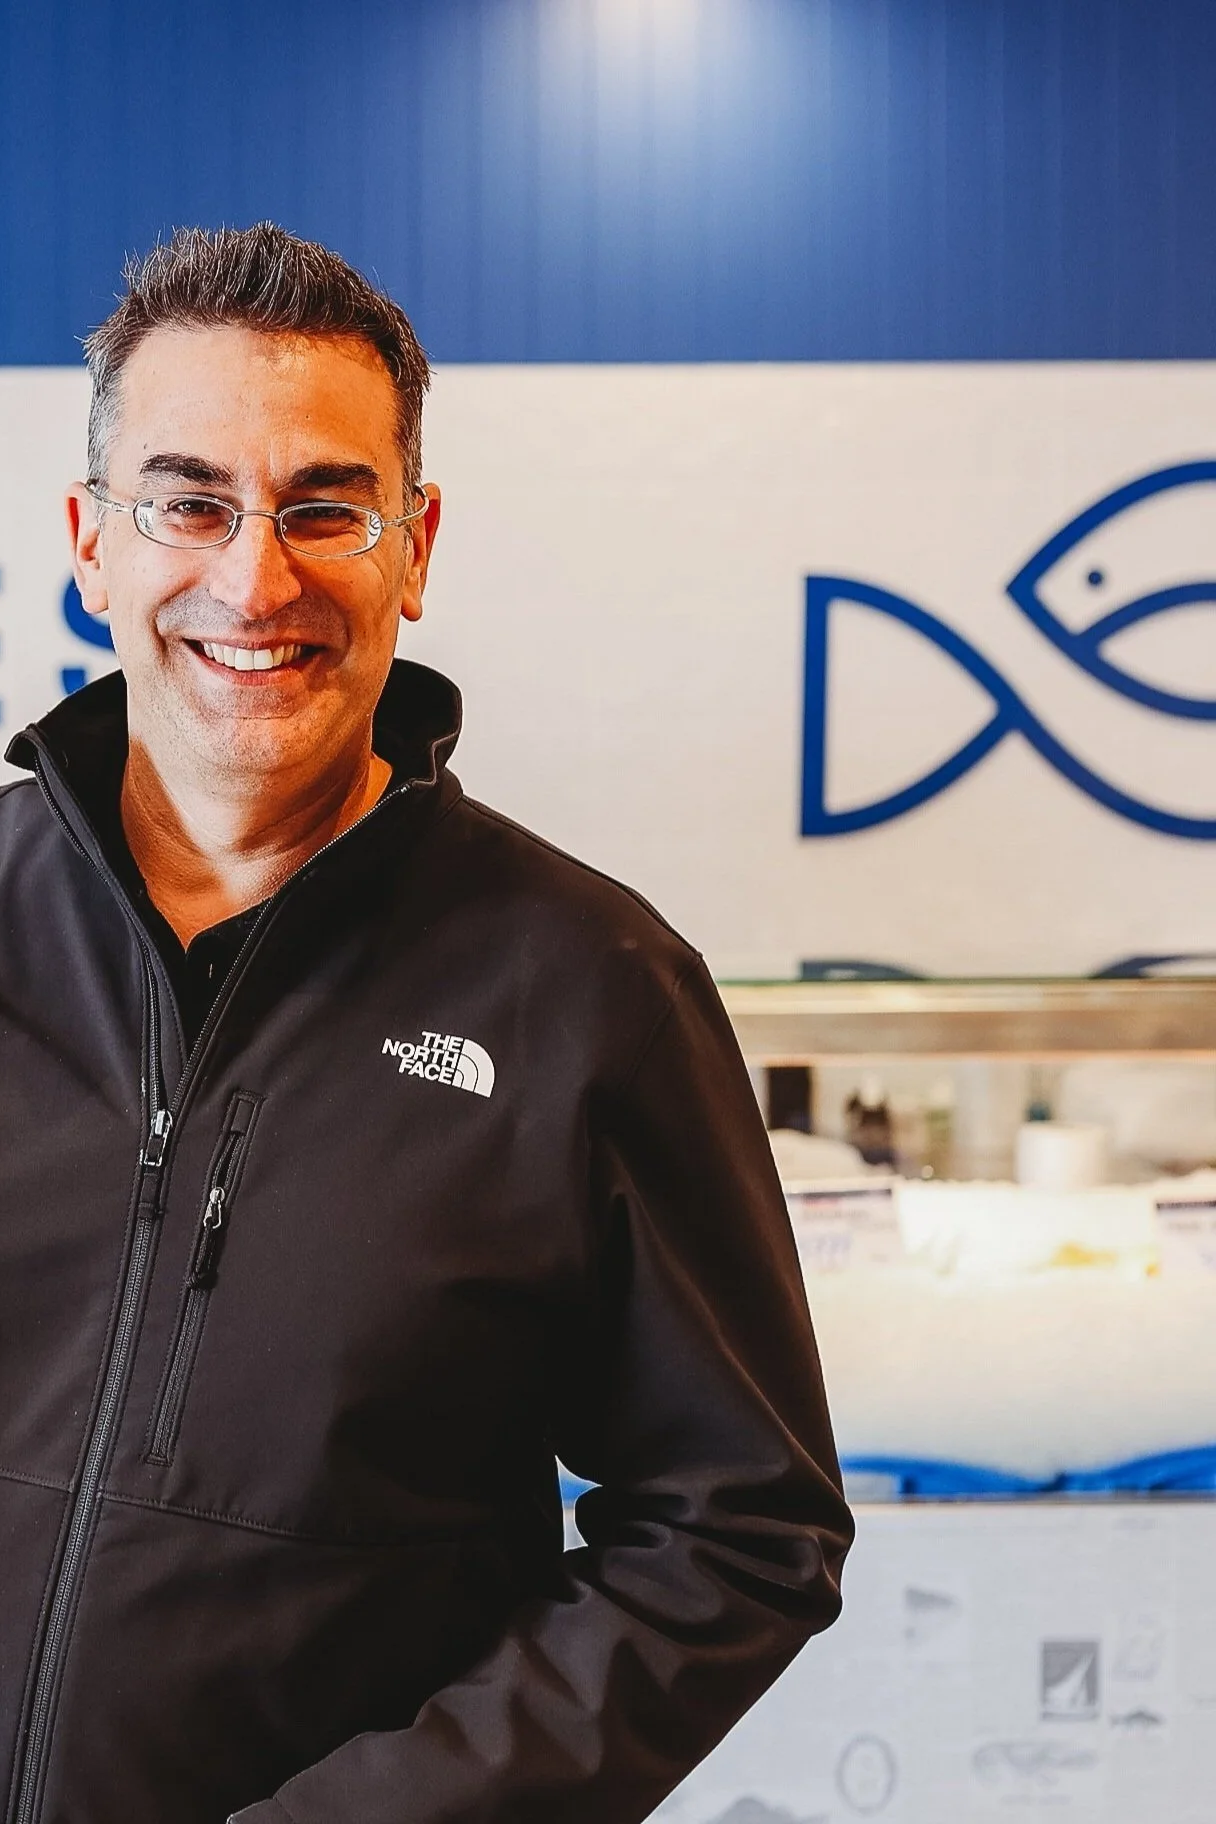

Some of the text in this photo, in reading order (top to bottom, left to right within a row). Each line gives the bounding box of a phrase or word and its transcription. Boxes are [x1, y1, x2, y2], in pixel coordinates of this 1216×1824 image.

[381, 1037, 459, 1069] NORTH
[421, 1030, 464, 1053] THE
[398, 1058, 455, 1085] FACE
